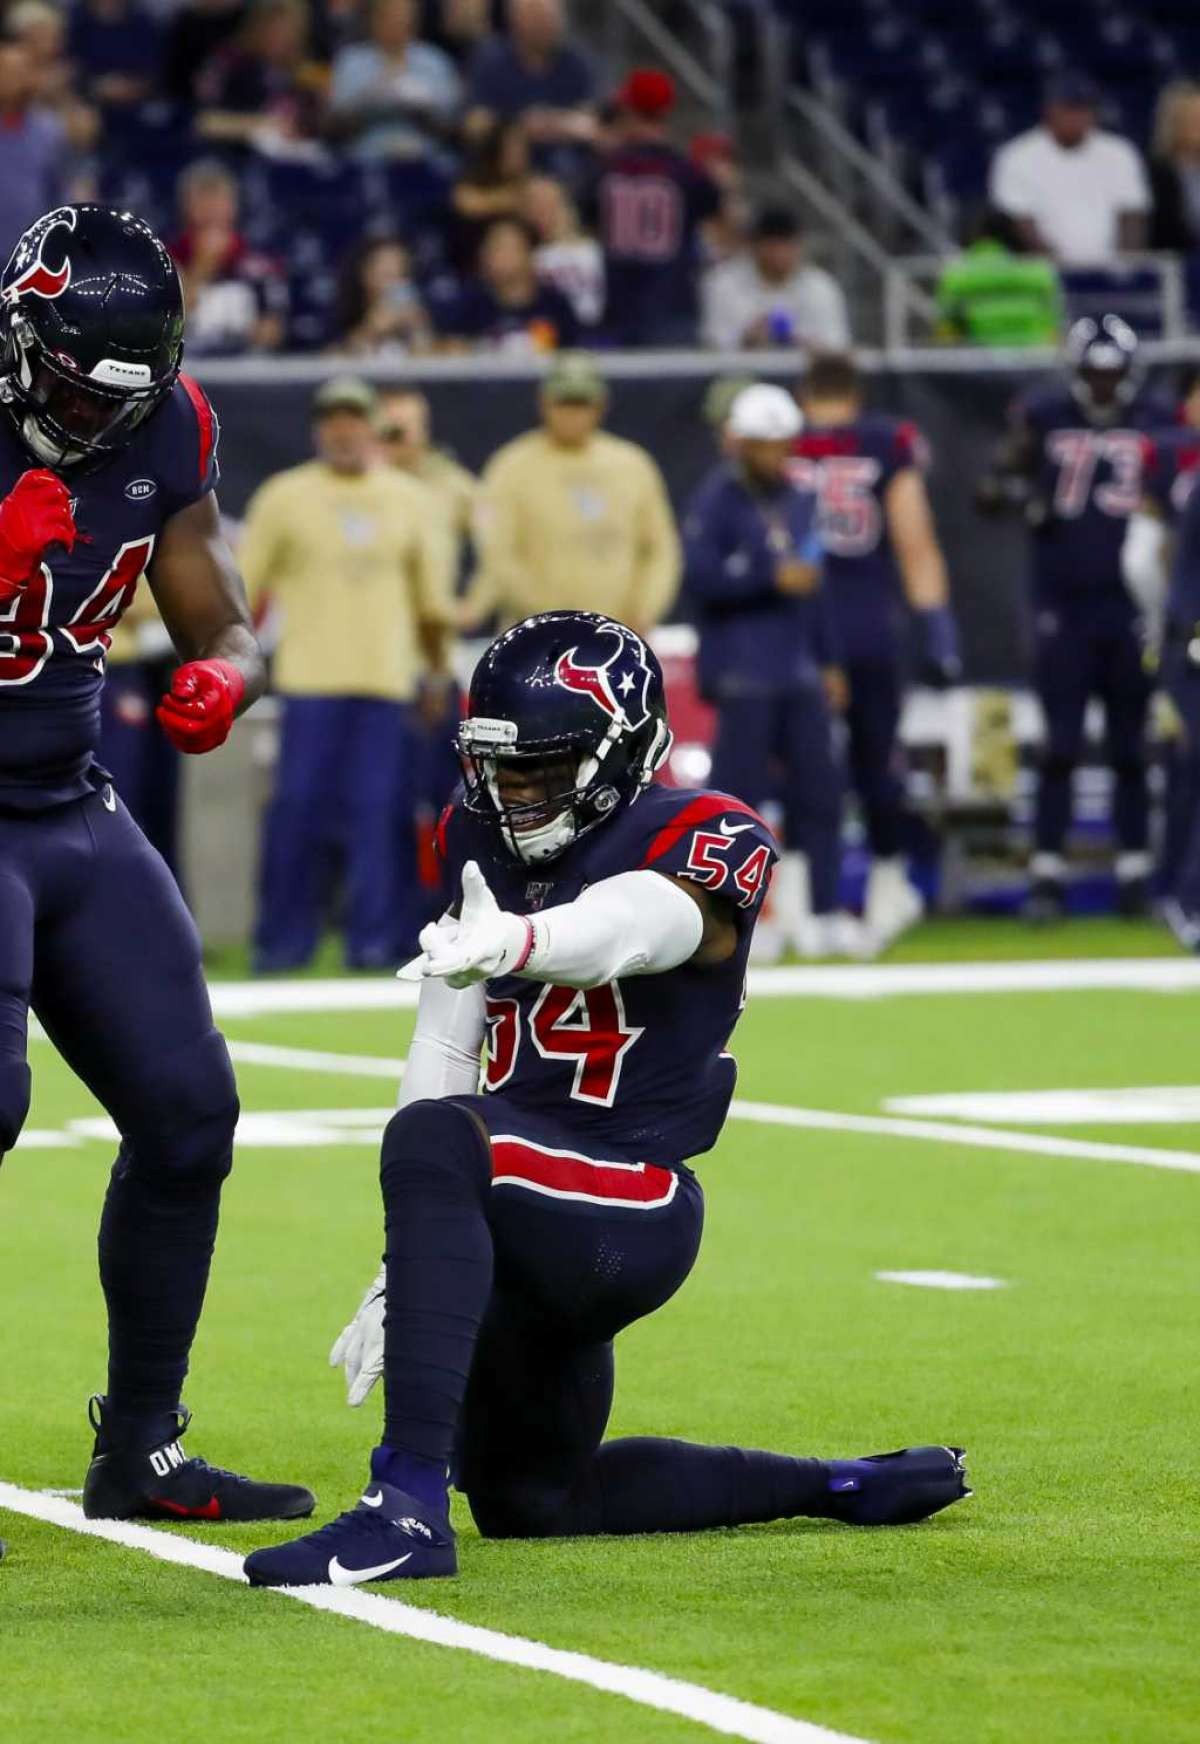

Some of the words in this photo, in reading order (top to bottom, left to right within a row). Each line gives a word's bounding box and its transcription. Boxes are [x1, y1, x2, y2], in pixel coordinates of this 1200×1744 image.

[603, 176, 681, 259] 10
[1044, 427, 1146, 519] 73
[677, 831, 771, 909] 54
[149, 1439, 187, 1477] OM
